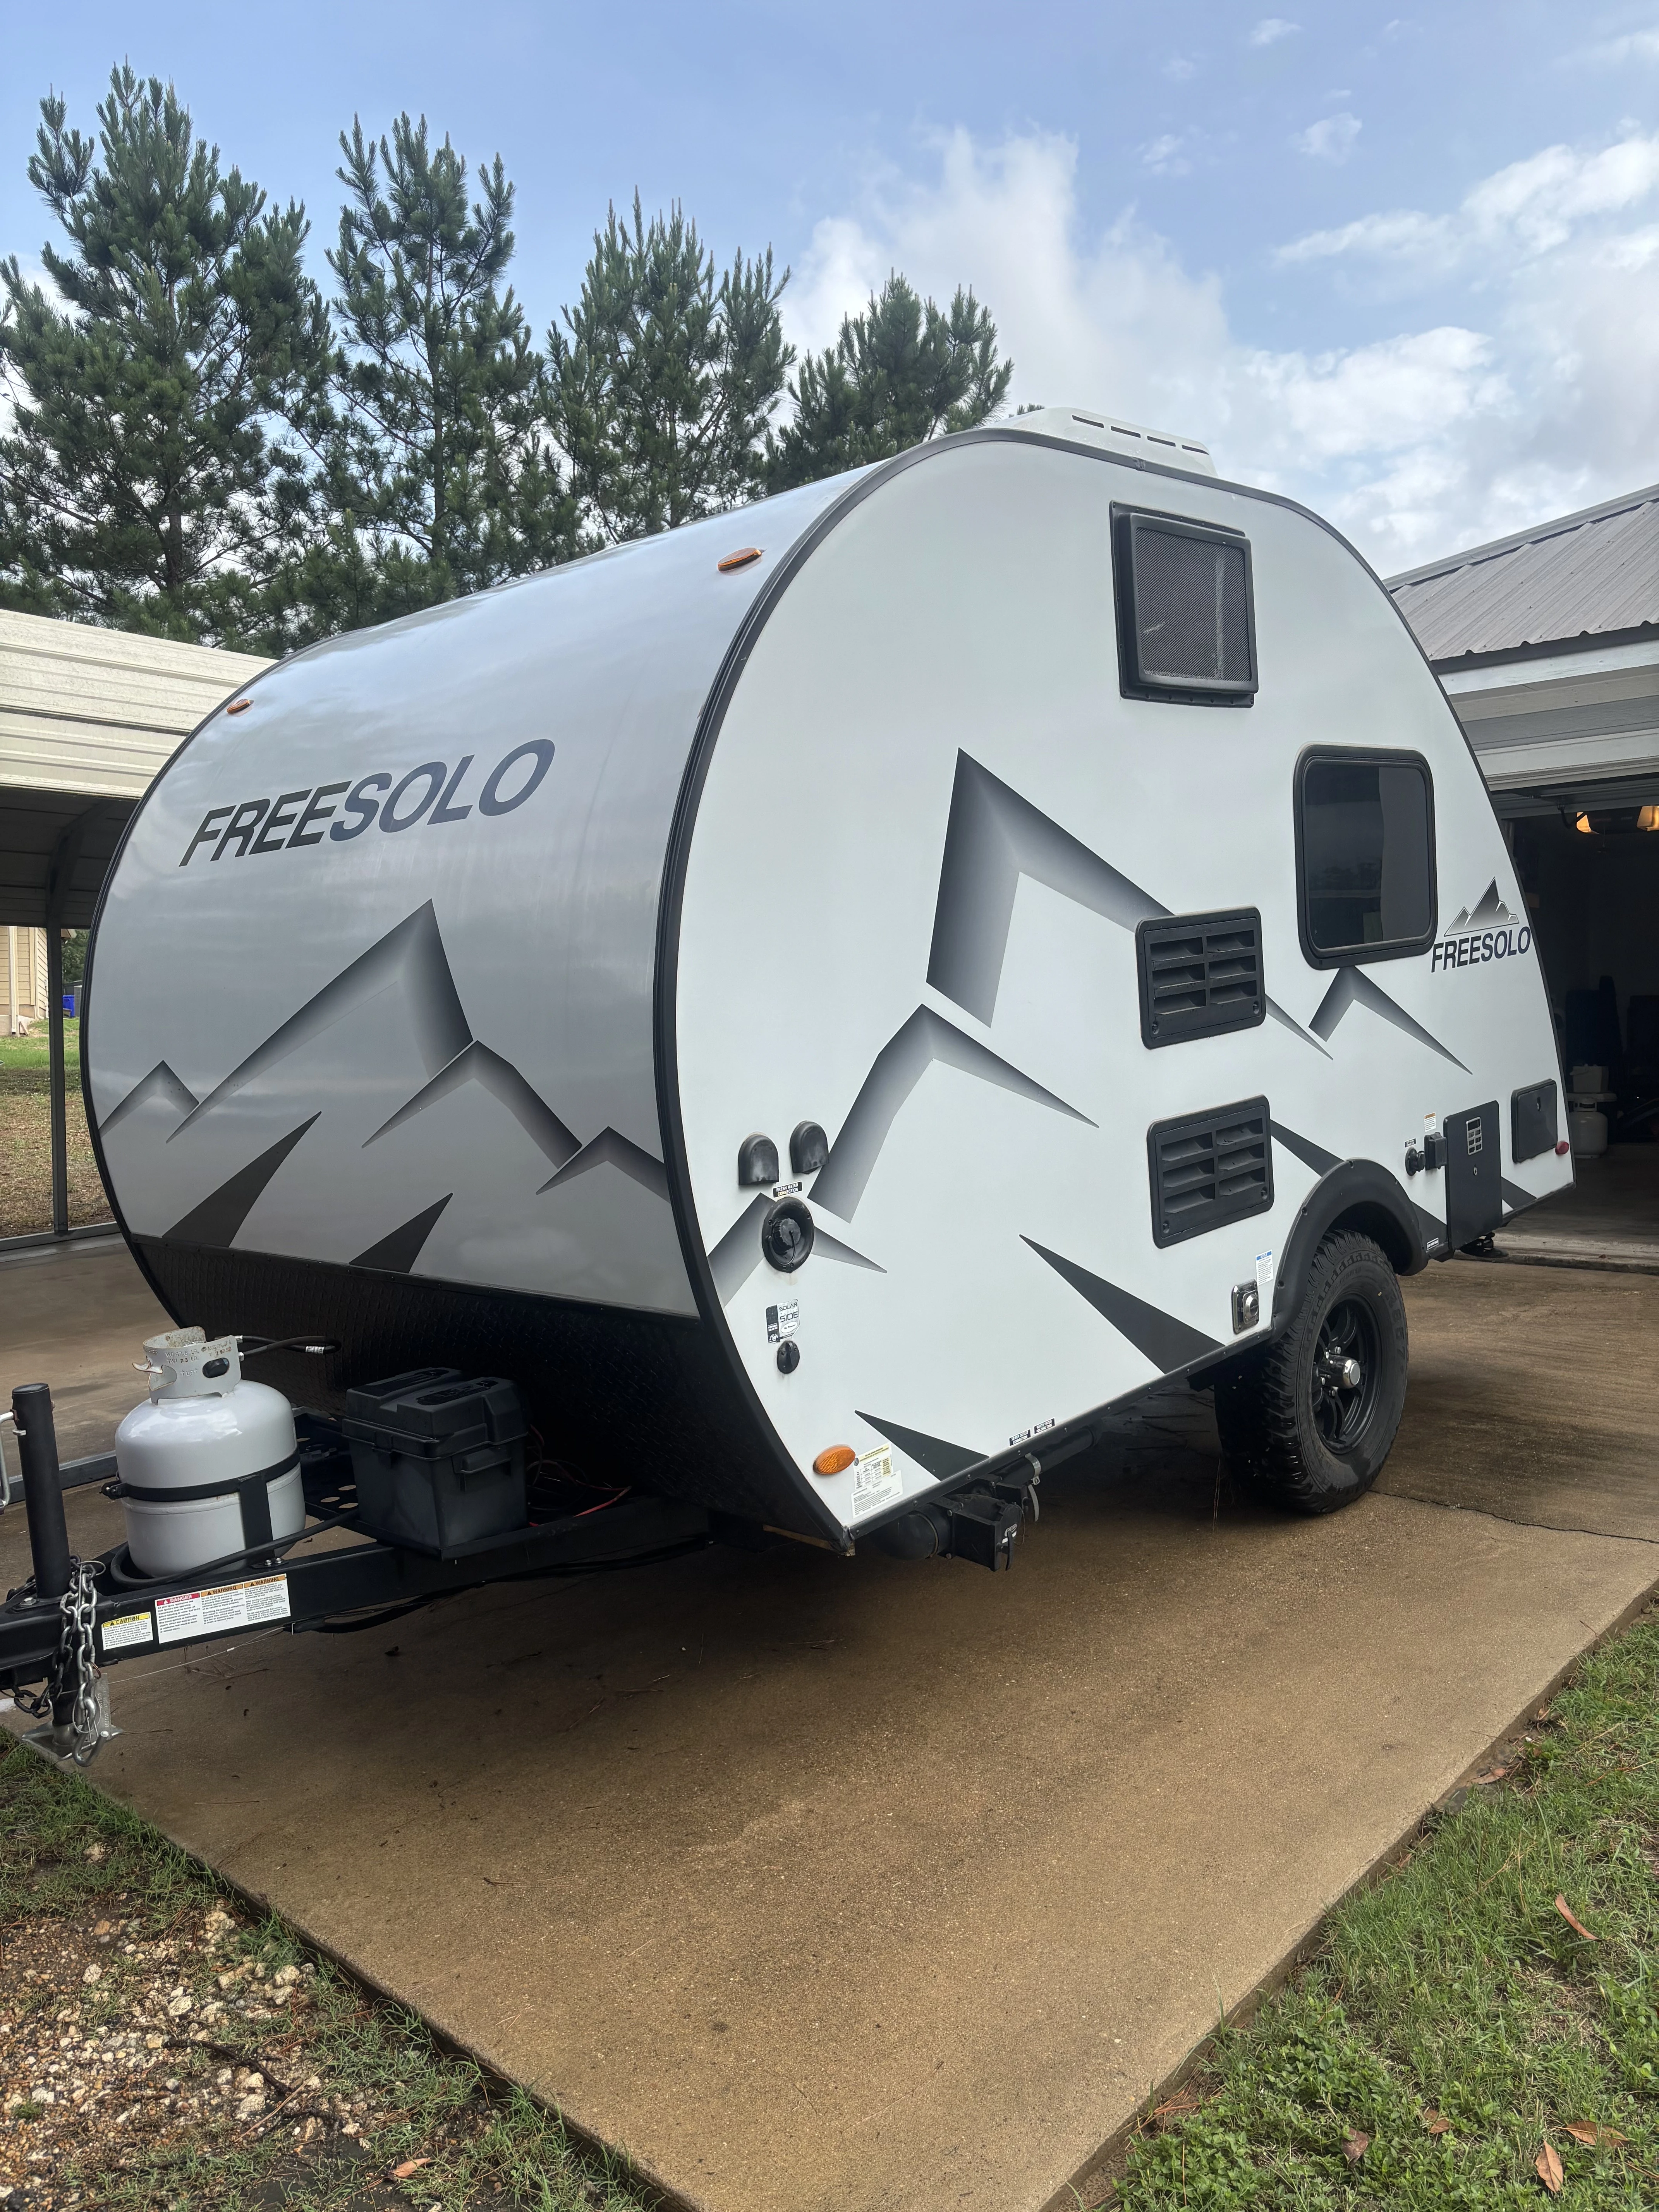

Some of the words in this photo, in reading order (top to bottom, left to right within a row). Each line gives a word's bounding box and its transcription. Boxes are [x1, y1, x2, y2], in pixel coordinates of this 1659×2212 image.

[179, 739, 555, 867] FREESOLO
[1431, 926, 1531, 973] FREESOLO
[777, 1187, 799, 1196] CONNECTION
[779, 1302, 797, 1312] SOLAR
[780, 1311, 799, 1323] SIDE
[213, 1585, 237, 1594] WARNING
[170, 1594, 192, 1603] DANGER
[116, 1615, 140, 1625] CAUTION
